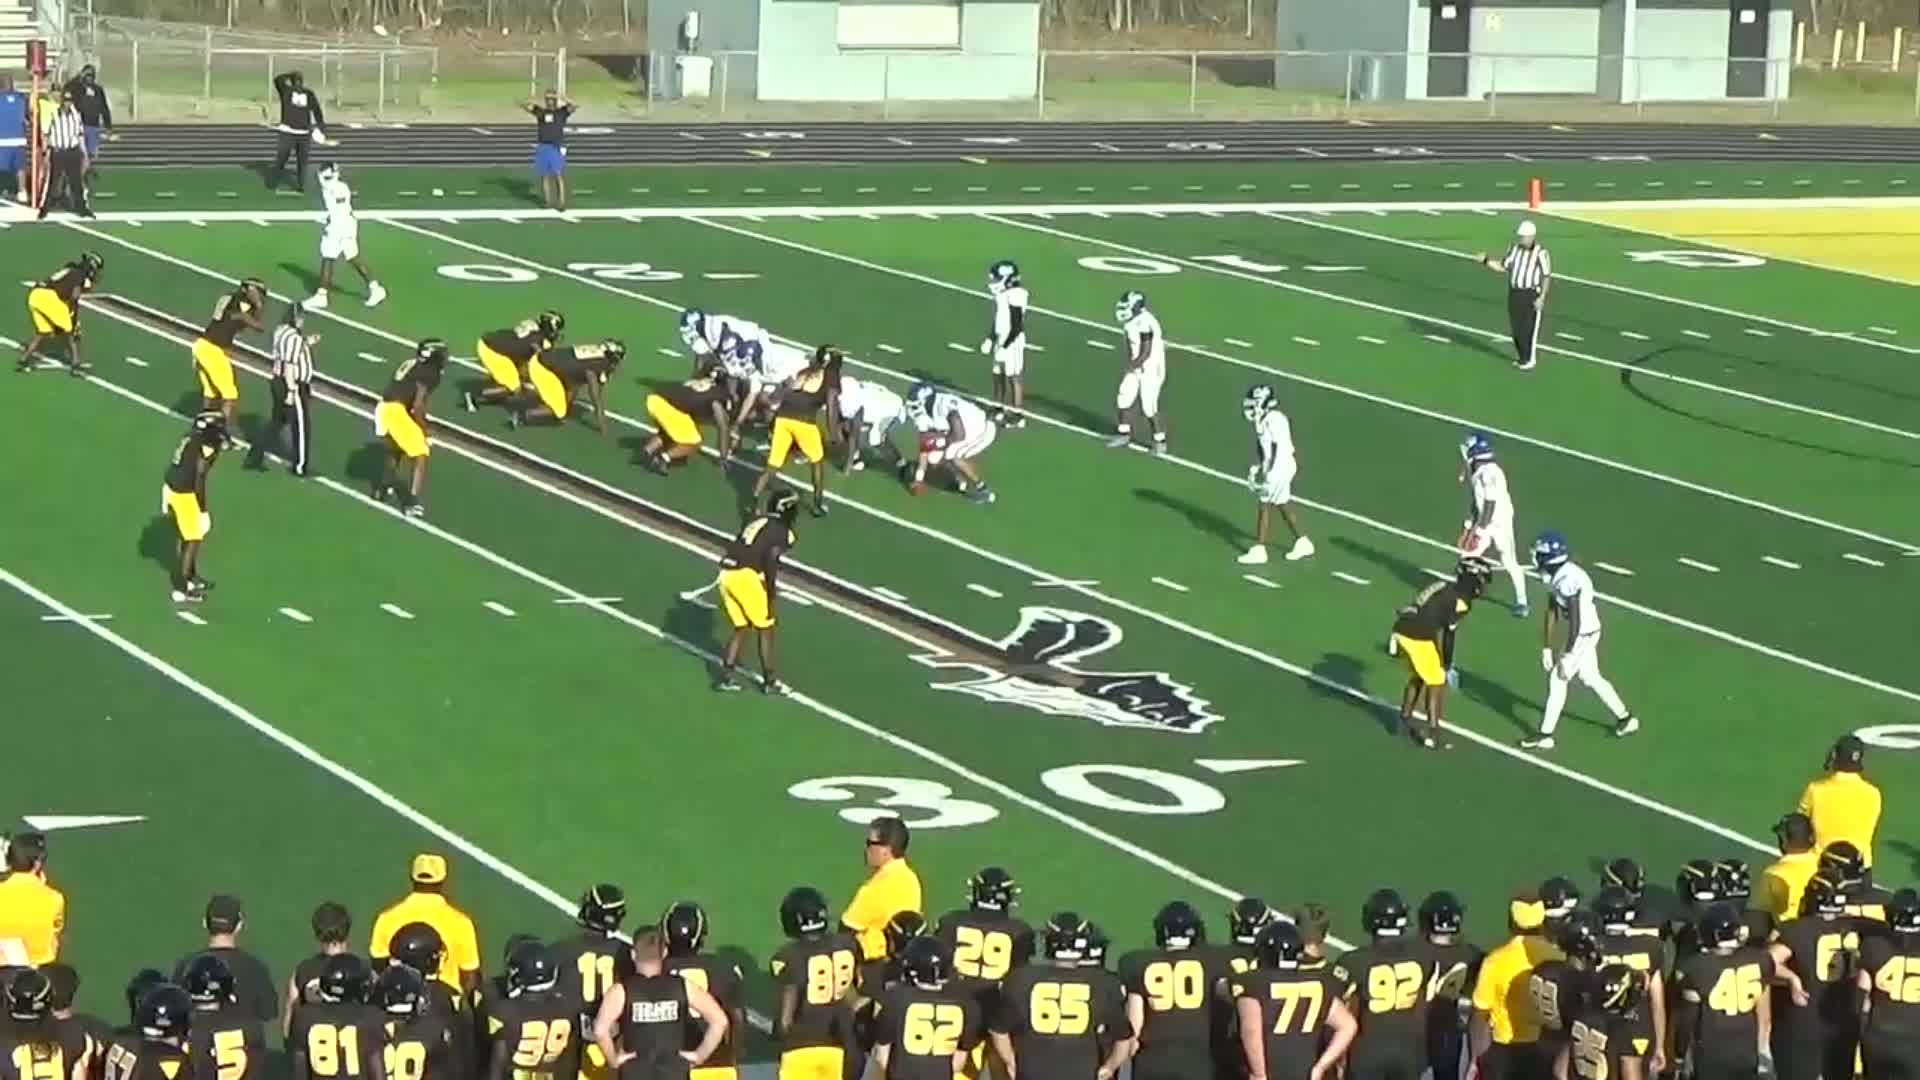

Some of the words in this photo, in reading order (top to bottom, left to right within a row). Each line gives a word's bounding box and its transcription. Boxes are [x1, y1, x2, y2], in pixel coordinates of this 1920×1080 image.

[787, 764, 1226, 828] 30
[577, 951, 615, 1003] 11
[953, 926, 1013, 980] 29
[1030, 981, 1091, 1035] 65
[1143, 959, 1204, 1011] 90
[1270, 980, 1324, 1034] 77
[1368, 961, 1423, 1014] 92
[1709, 963, 1763, 1017] 46
[213, 1029, 247, 1080] 5
[308, 1023, 361, 1076] 81
[903, 1002, 964, 1057] 62
